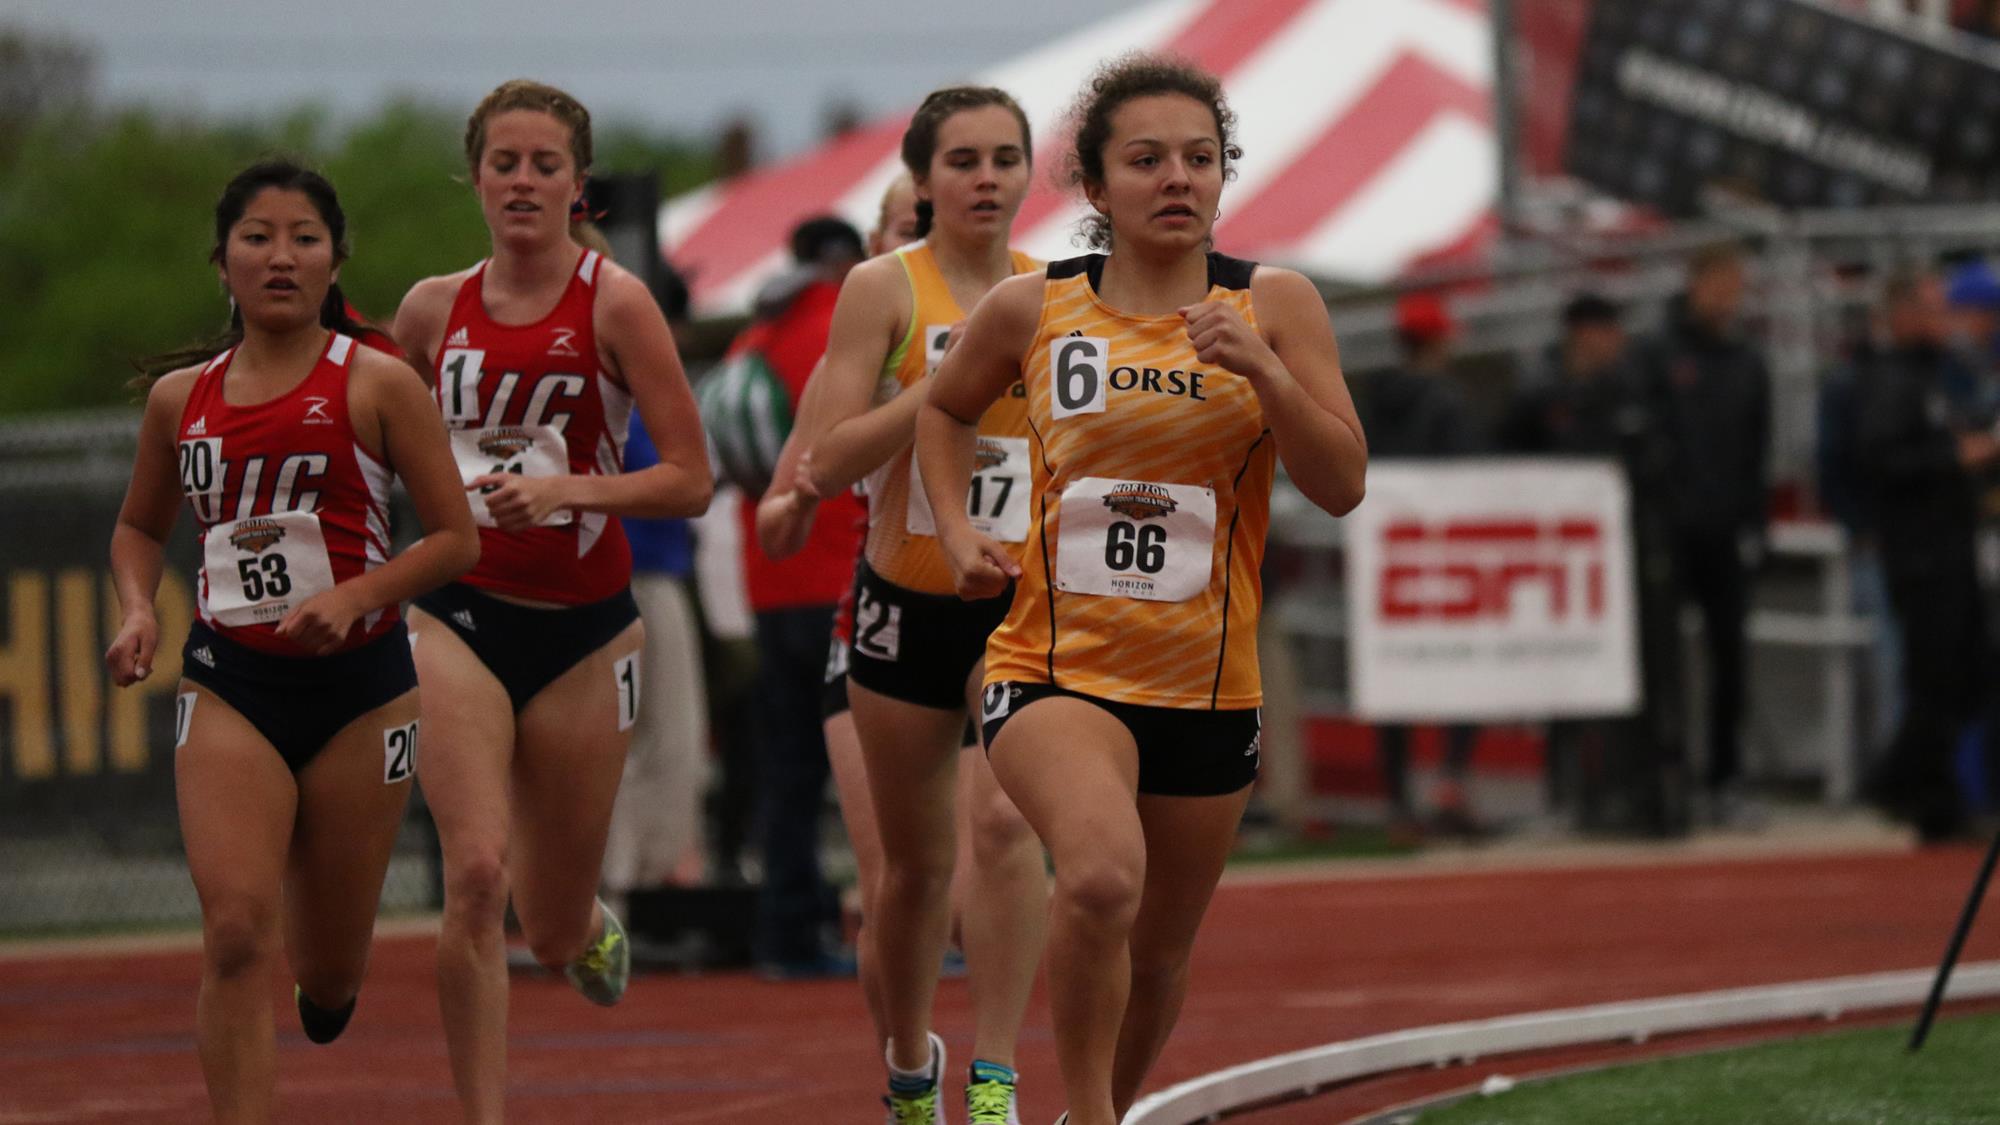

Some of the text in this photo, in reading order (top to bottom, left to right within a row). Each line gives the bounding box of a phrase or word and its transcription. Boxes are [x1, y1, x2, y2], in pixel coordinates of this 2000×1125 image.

[447, 354, 467, 416] 1
[448, 370, 586, 434] IC
[1057, 340, 1098, 411] 6
[1109, 366, 1206, 401] ORSE
[181, 440, 213, 493] 20
[1112, 483, 1170, 498] HORIZON
[970, 475, 1013, 518] 17
[1105, 521, 1167, 574] 66
[1380, 519, 1604, 621] ESPN
[238, 553, 292, 602] 53
[1111, 579, 1154, 591] HORIZON
[253, 604, 289, 616] HORIZON
[621, 660, 634, 721] 1
[388, 724, 417, 780] 20
